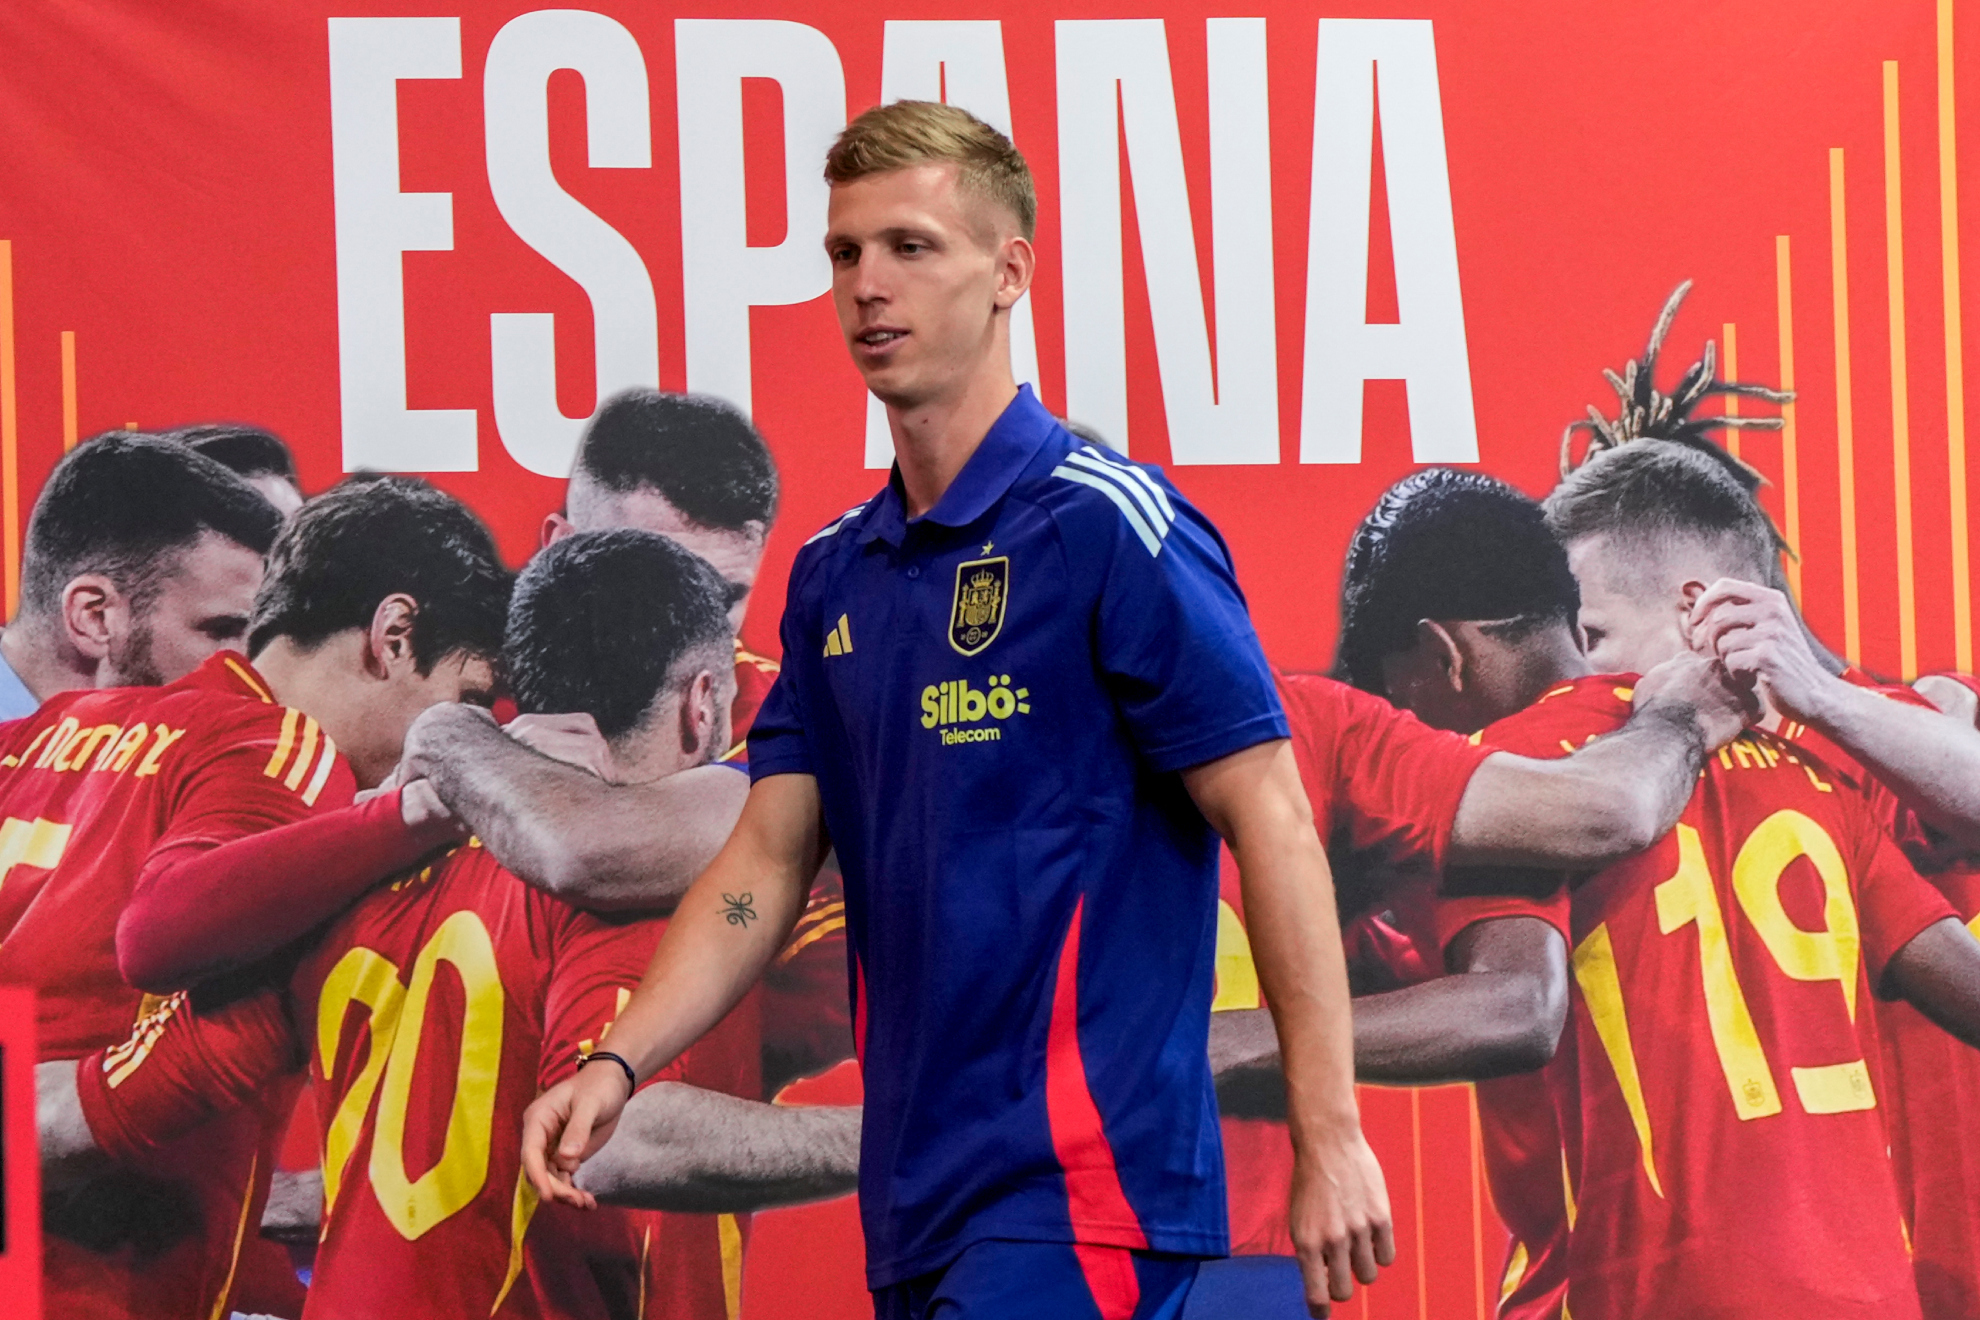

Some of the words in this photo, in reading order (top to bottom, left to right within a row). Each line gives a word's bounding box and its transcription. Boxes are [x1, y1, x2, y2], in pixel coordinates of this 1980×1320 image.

[939, 727, 1001, 746] Telecom
[317, 910, 504, 1241] 20
[1654, 808, 1877, 1121] 19
